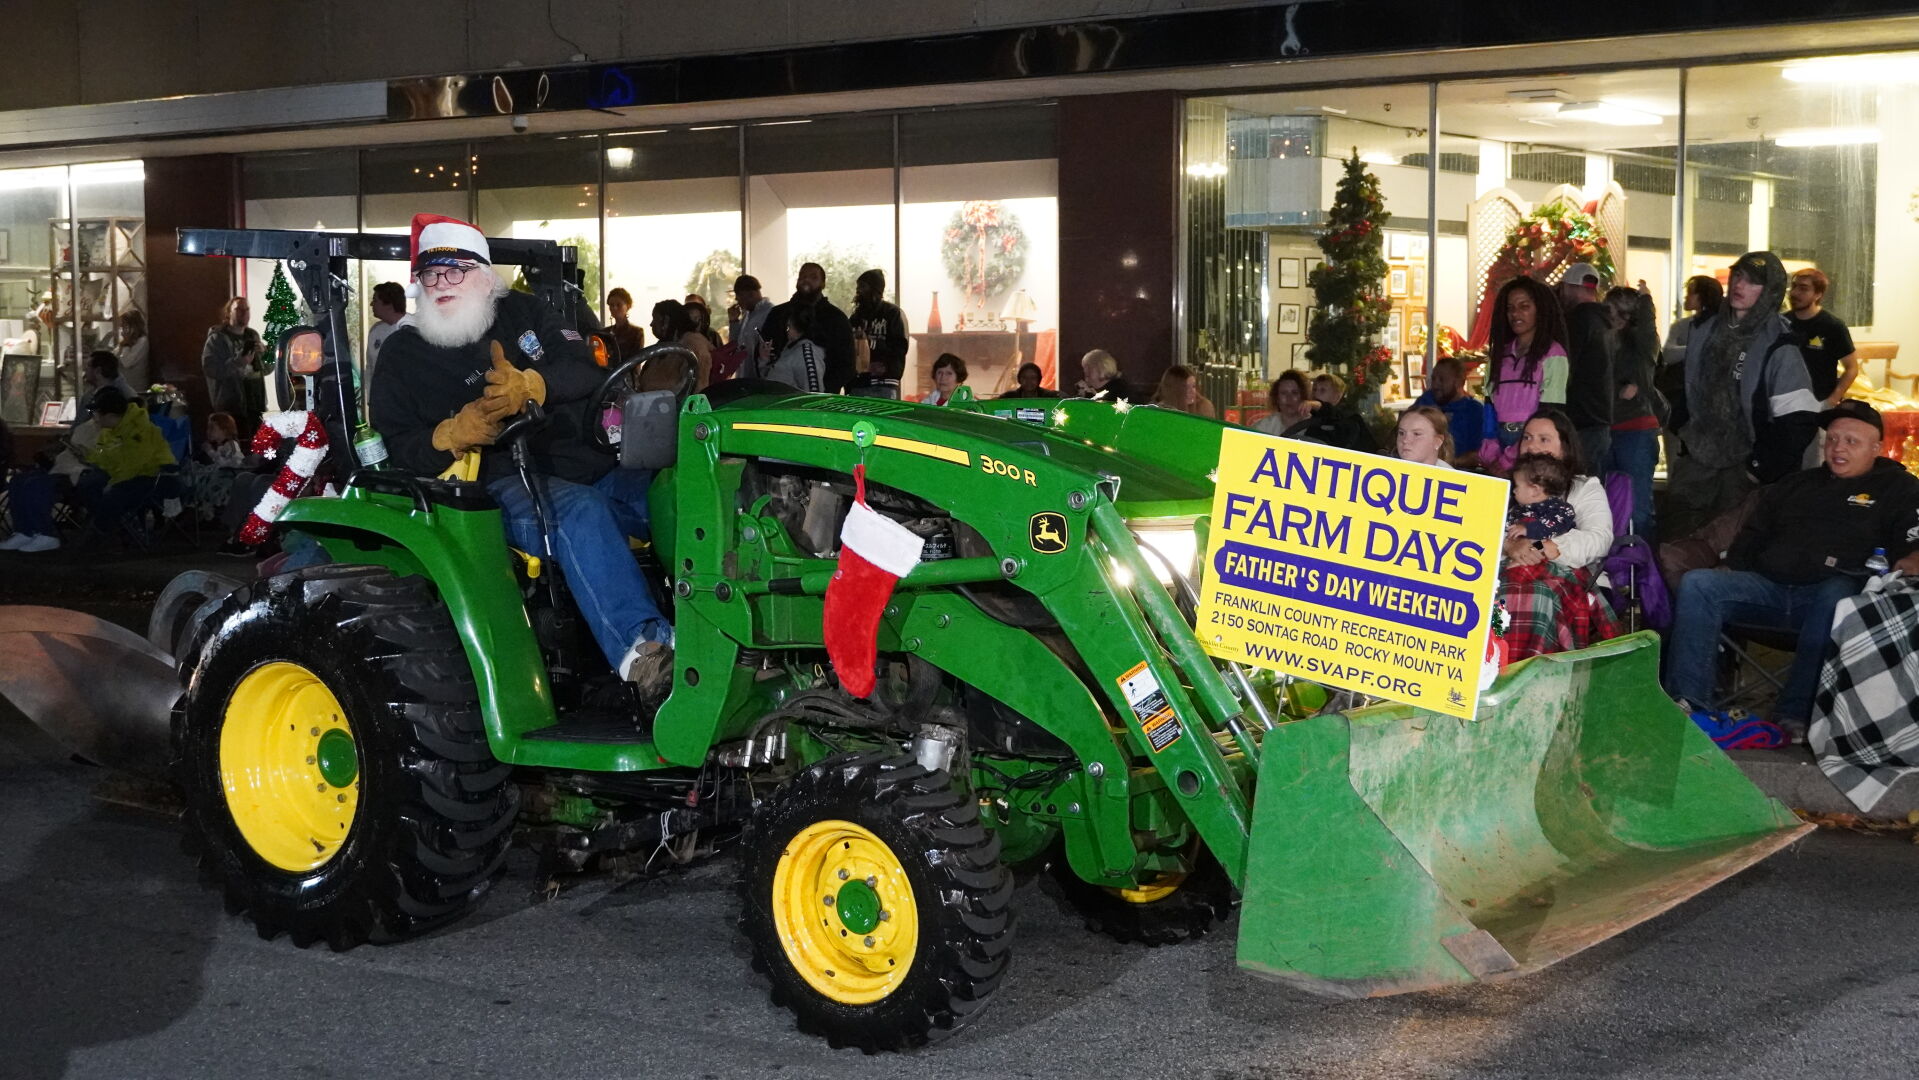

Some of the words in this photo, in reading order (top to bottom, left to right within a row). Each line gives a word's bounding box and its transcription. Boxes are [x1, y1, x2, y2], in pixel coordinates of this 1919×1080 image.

[980, 454, 1021, 480] 300
[1023, 468, 1038, 488] R
[1250, 447, 1467, 525] ANTIQUE
[1223, 492, 1353, 555] FARM
[1363, 520, 1486, 582] DAYS
[1224, 551, 1320, 592] FATHER'S
[1324, 574, 1369, 602] DAY
[1368, 582, 1468, 626] WEEKEND
[1211, 611, 1244, 629] 2150
[1247, 618, 1299, 641] SONTAG
[1302, 631, 1339, 651] ROAD
[1345, 641, 1391, 663] ROCKY
[1393, 652, 1444, 676] MOUNT
[1446, 665, 1464, 682] VA
[1214, 591, 1281, 618] FRANKLIN
[1284, 607, 1339, 630] COUNTY
[1340, 620, 1427, 651] RECREATION
[1430, 641, 1467, 661] PARK
[1245, 641, 1423, 697] WWW.SVAPF.ORG
